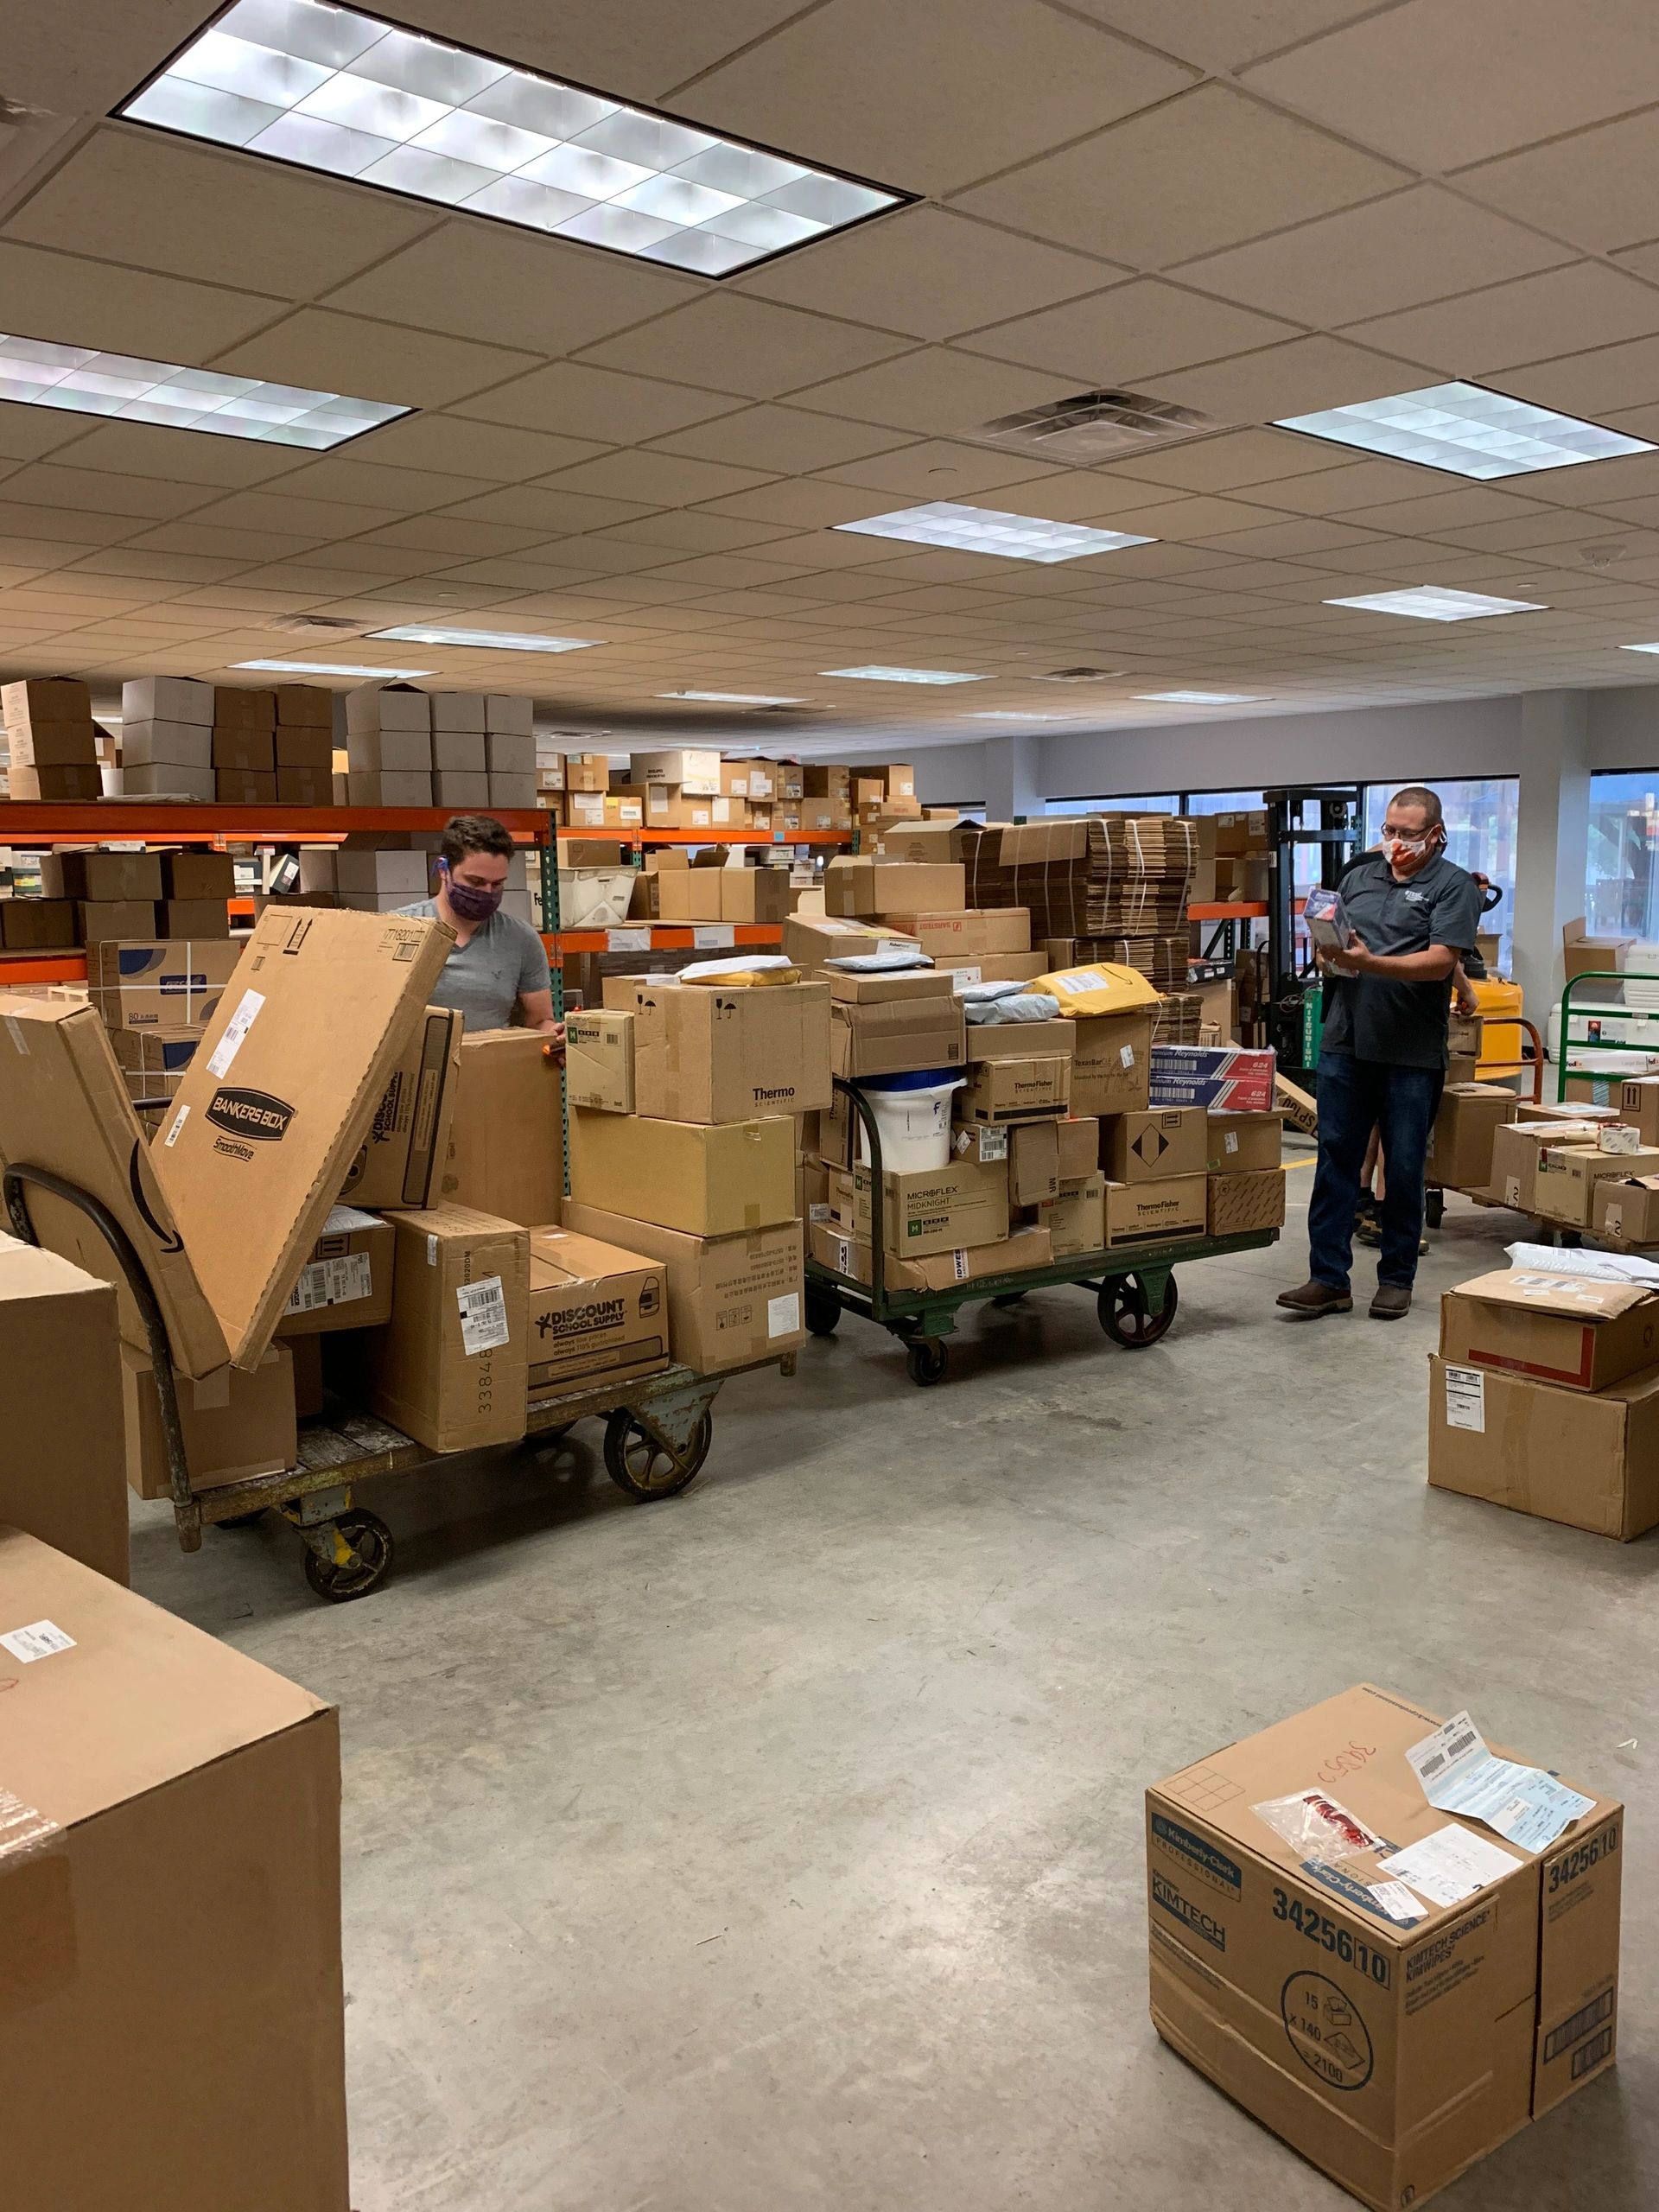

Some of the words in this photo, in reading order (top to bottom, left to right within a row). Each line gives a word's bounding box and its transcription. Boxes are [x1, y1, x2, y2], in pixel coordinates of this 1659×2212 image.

[1305, 1002, 1313, 1068] MITSUBISHI
[1174, 1050, 1209, 1058] Reynolds
[1173, 1077, 1207, 1086] Reynolds
[753, 1087, 795, 1101] Thermo
[754, 1098, 795, 1108] SCIENTIFIC
[213, 1096, 263, 1123] BANKERS
[260, 1111, 288, 1130] BOX
[213, 1138, 255, 1160] SmoothMove
[907, 1185, 958, 1200] MICROFLEX
[907, 1198, 950, 1211] MIDKNIGHT
[1137, 1207, 1179, 1217] SCIENTIFIC
[551, 1298, 625, 1325] DISCOUNT
[552, 1319, 594, 1335] SCHOOL
[593, 1312, 625, 1327] SUPPLY
[1155, 1837, 1232, 1893] PROFESSIONAL
[1168, 1827, 1235, 1879] Kimberly-Clark
[1548, 1838, 1599, 1894] 34256
[1152, 1877, 1226, 1943] KIMTECH
[1273, 1887, 1353, 1963] 34256
[1358, 1944, 1387, 1983] 10
[1407, 1936, 1447, 1969] KIMTECH
[1305, 1991, 1319, 2011] 15
[1301, 2018, 1321, 2042] 140
[1314, 2053, 1343, 2083] 2100
